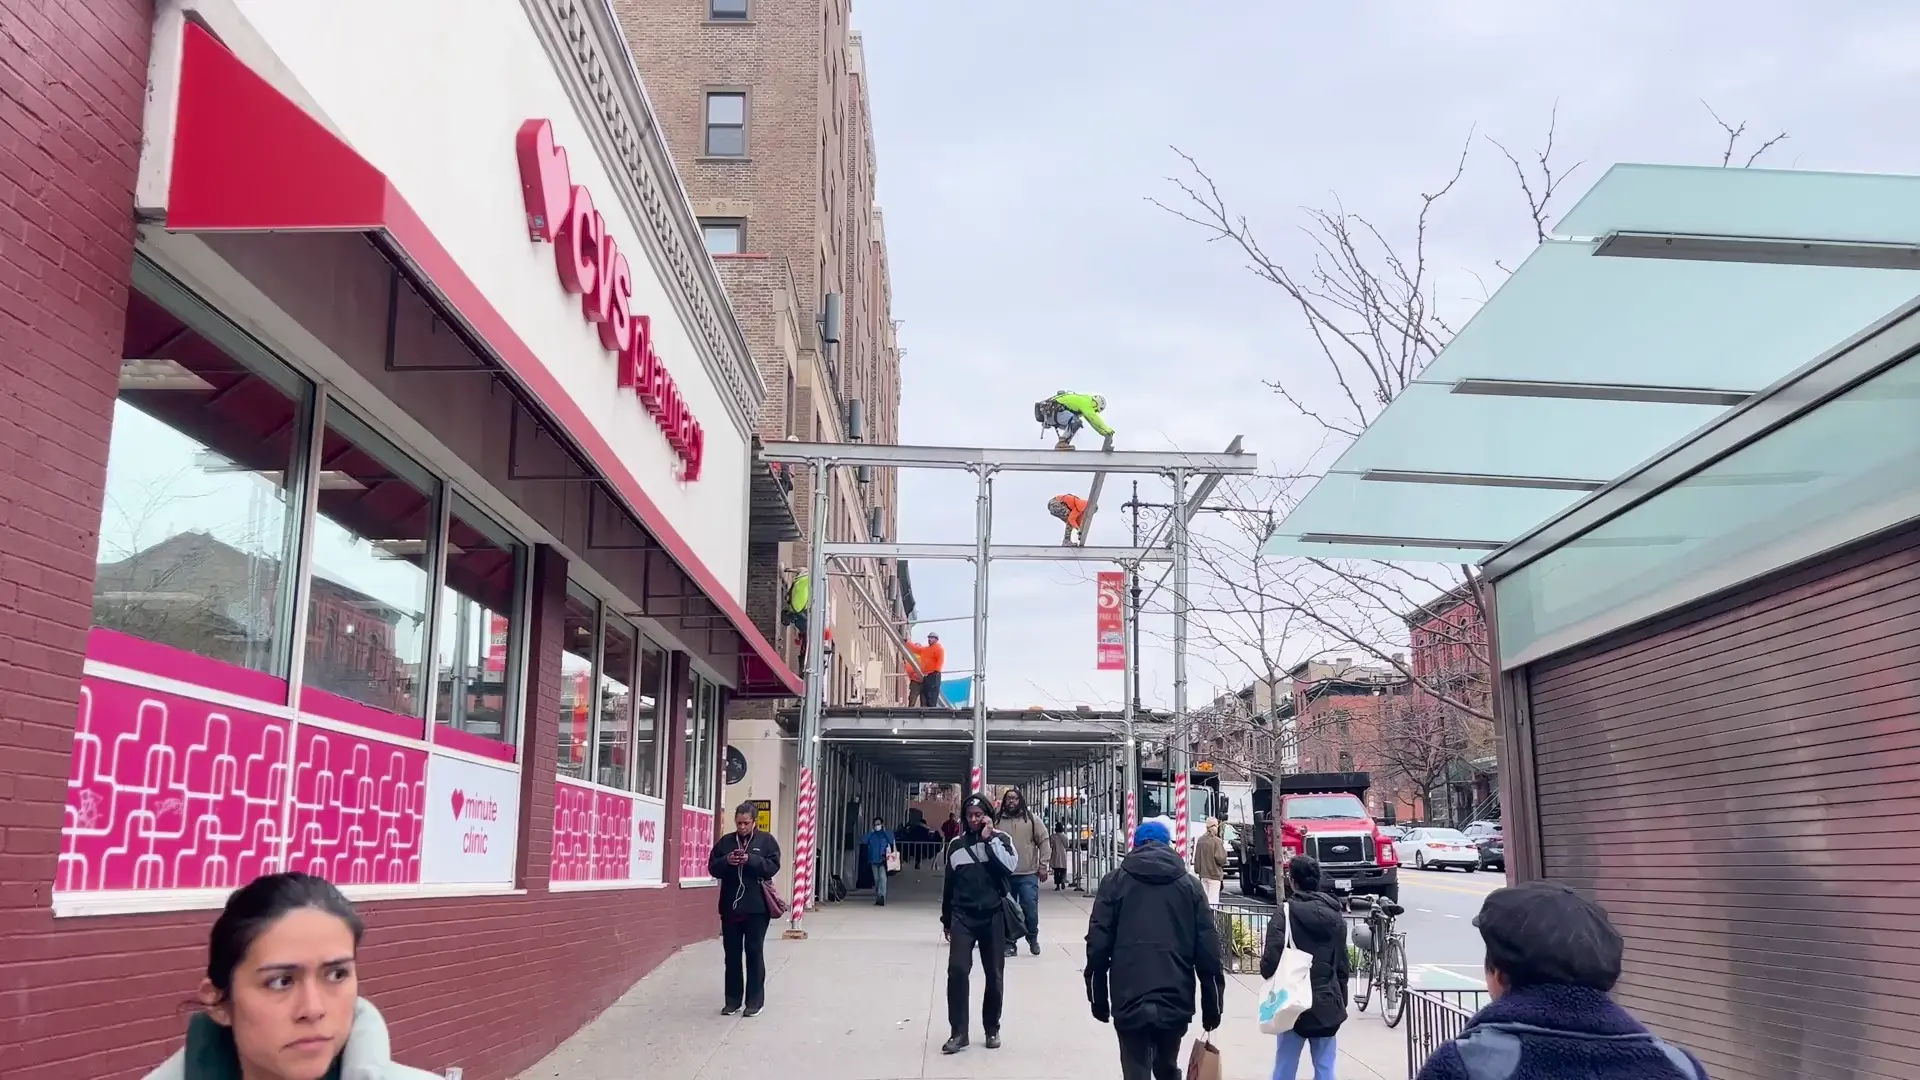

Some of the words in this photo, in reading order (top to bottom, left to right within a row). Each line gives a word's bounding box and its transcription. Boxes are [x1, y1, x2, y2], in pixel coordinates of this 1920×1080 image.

[554, 185, 632, 351] CVS
[465, 792, 498, 821] minute
[463, 826, 489, 854] clinic
[644, 819, 656, 844] CVS
